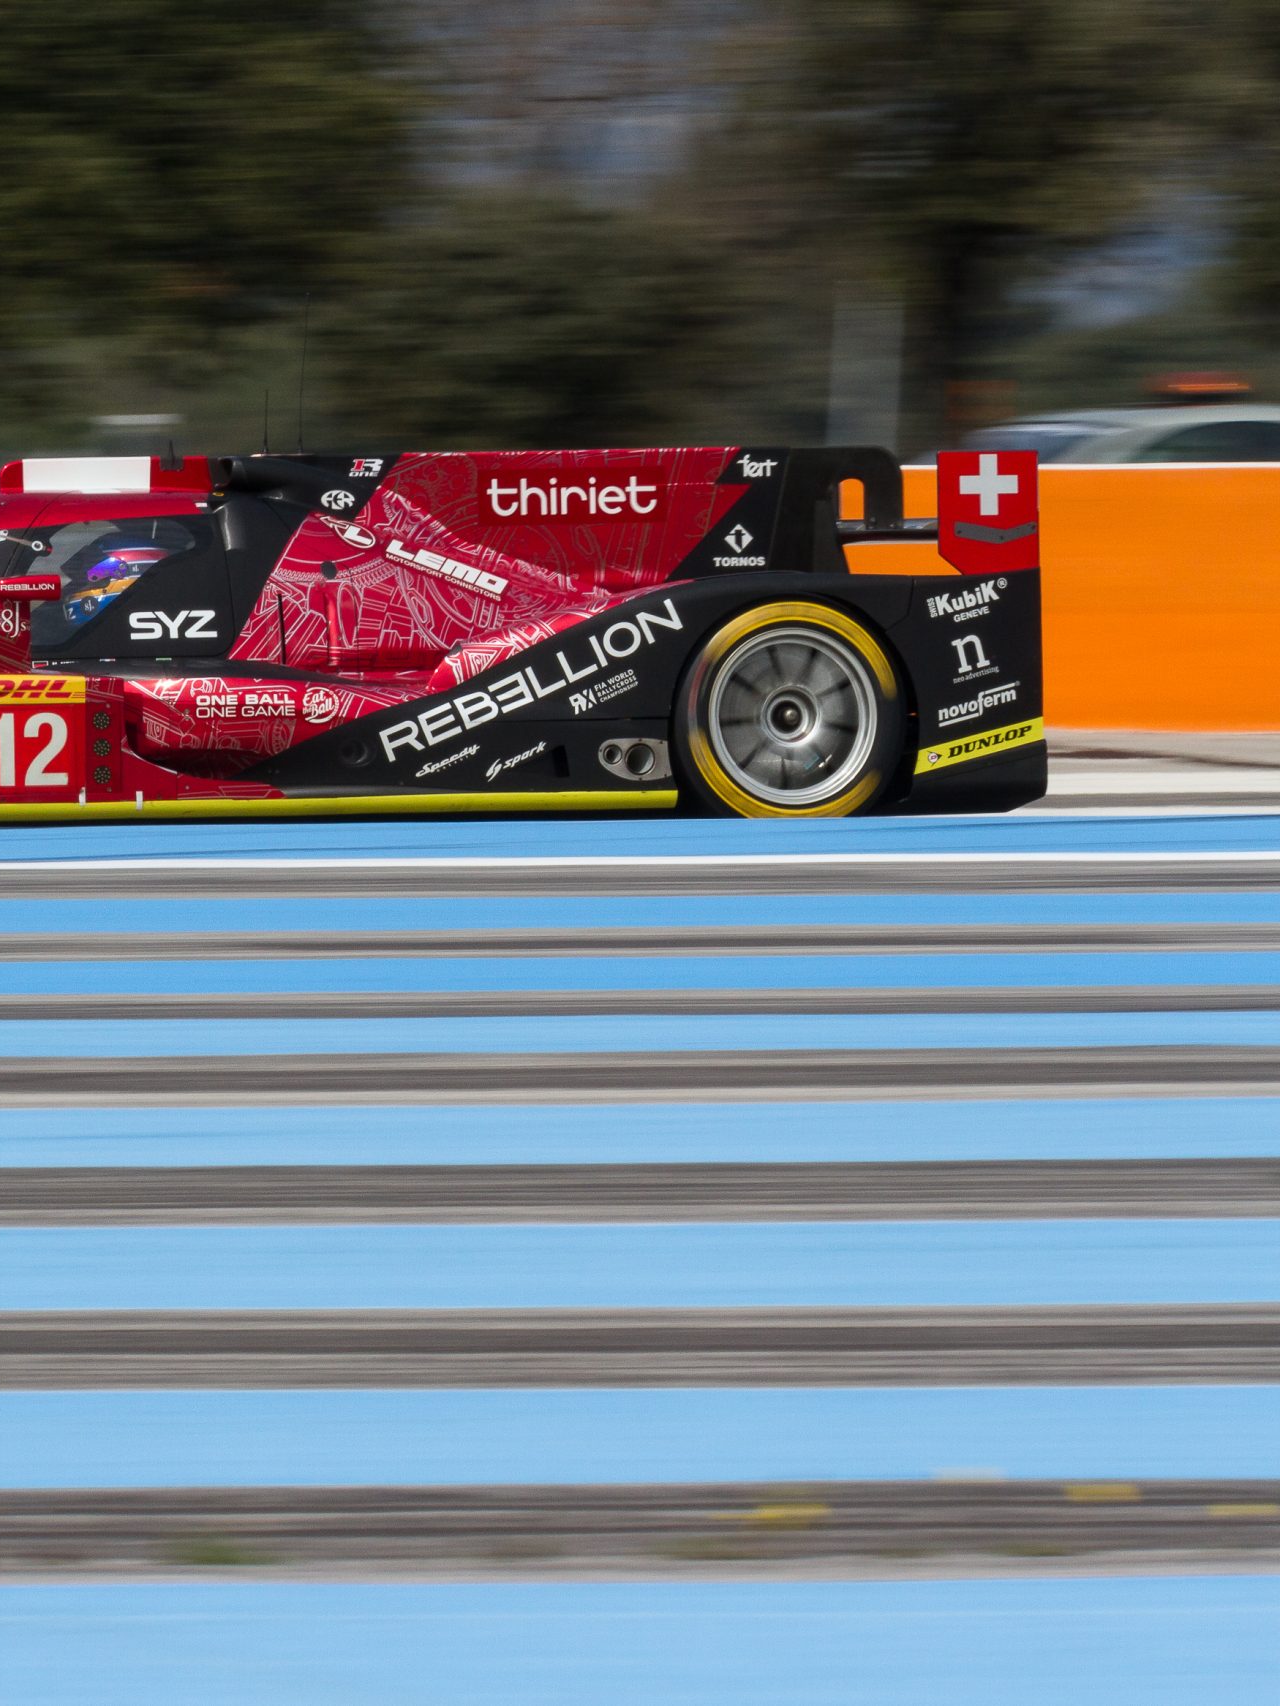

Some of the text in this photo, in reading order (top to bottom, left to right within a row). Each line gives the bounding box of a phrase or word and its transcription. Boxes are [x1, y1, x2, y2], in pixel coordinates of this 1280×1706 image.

[736, 453, 778, 478] fert
[486, 475, 658, 517] thiriet
[385, 539, 509, 595] LEMO
[713, 556, 766, 567] TORNOS
[0, 583, 55, 592] REBELLION
[385, 552, 502, 602] MOTORSPORT CONNECTORS
[128, 609, 218, 640] SYZ
[953, 605, 990, 622] GENEVE
[951, 634, 991, 674] n
[378, 598, 684, 762] REBELLION
[593, 668, 634, 692] FIA WORLD
[965, 666, 1000, 680] advertising
[302, 690, 326, 706] Eat
[596, 675, 637, 698] RALLYCROSS
[599, 681, 639, 703] CHAMPIONSHIP
[195, 693, 296, 706] ONE BALL
[195, 705, 296, 718] ONE GAME
[306, 697, 335, 719] Ball
[938, 688, 1017, 721] novoferm
[947, 725, 1032, 758] DUNLOP
[415, 744, 480, 778] Speedy
[503, 741, 547, 768] spark
